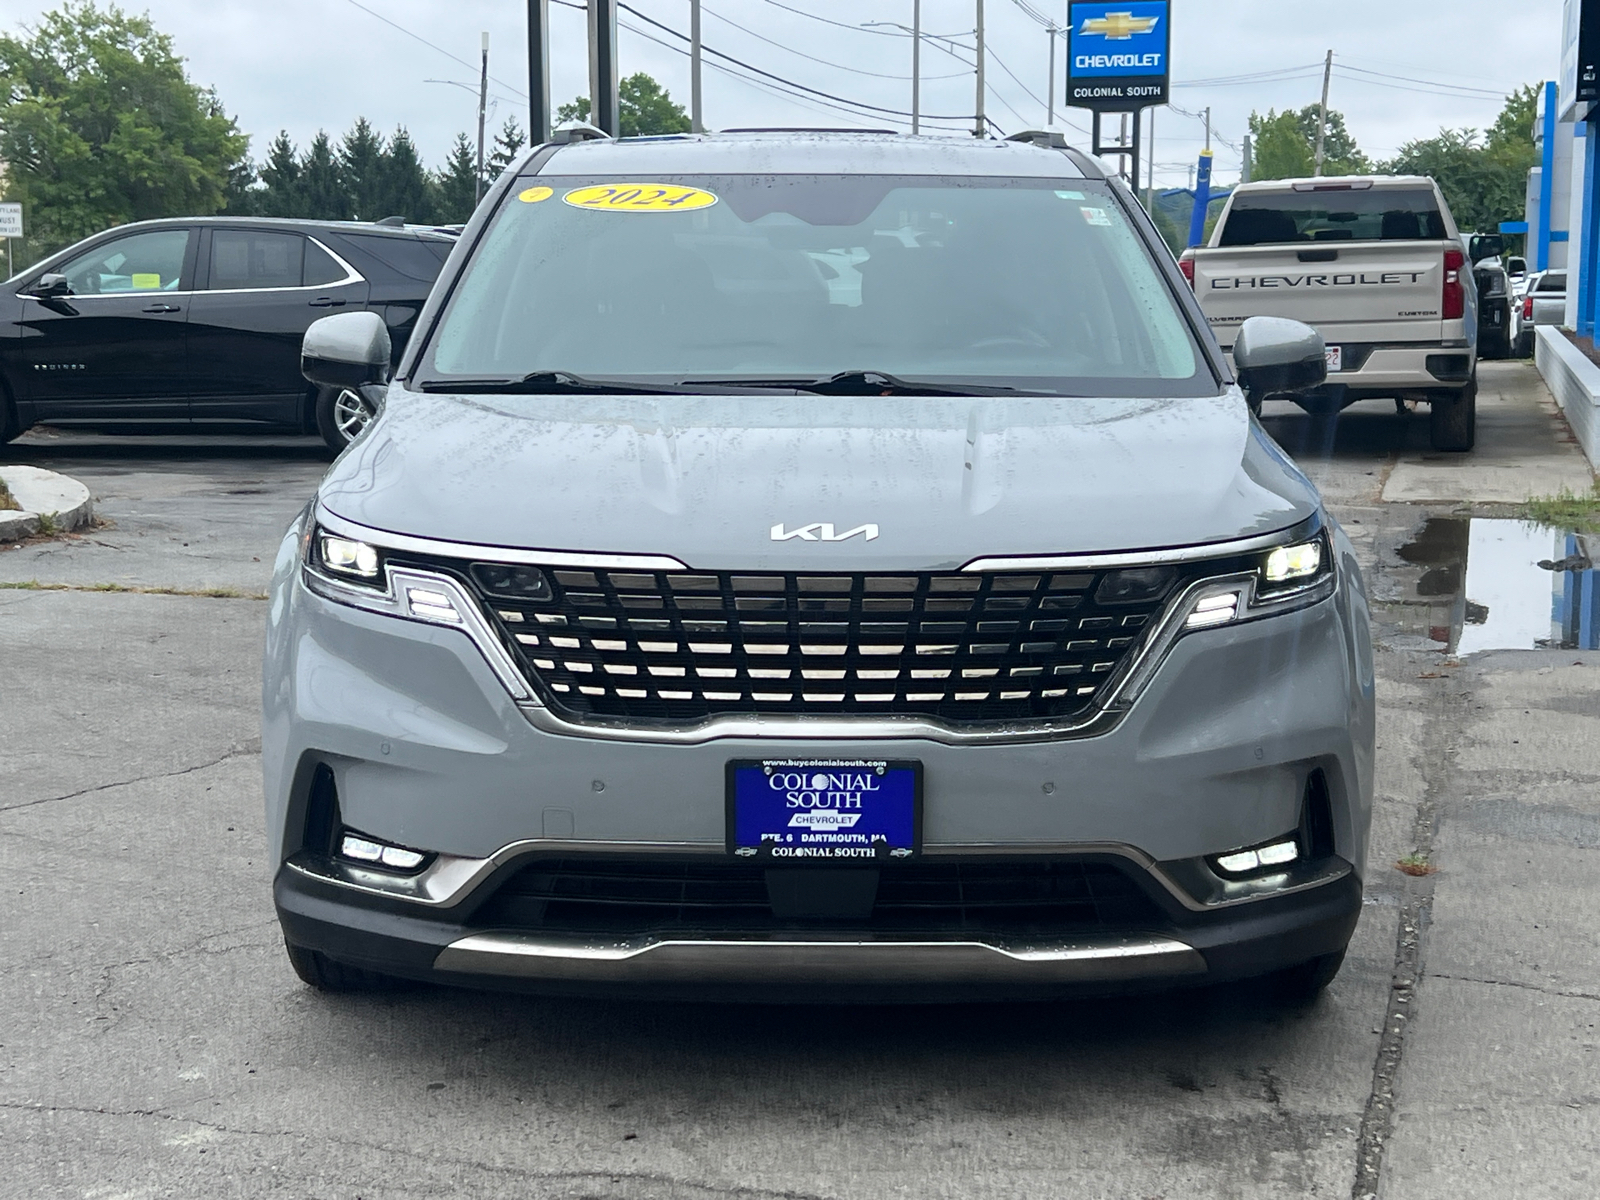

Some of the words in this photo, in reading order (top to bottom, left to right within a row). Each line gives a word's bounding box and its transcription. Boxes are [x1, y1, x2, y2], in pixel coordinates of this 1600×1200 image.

[1075, 53, 1161, 68] CHEVROLET
[1074, 87, 1123, 98] COLONIAL
[1126, 86, 1161, 97] SOUTH
[582, 188, 698, 206] 2024
[1211, 271, 1426, 290] CHEVROLET
[770, 522, 879, 542] KIA
[762, 760, 887, 768] www.buycolonialsouth.com
[769, 773, 880, 791] COLONIAL
[786, 791, 862, 808] SOUTH
[795, 815, 853, 824] CHEVROLET
[786, 833, 793, 843] 6
[801, 833, 869, 844] DARTMOUTH,
[772, 847, 833, 857] COLONIAL
[834, 847, 876, 857] SOUTH
